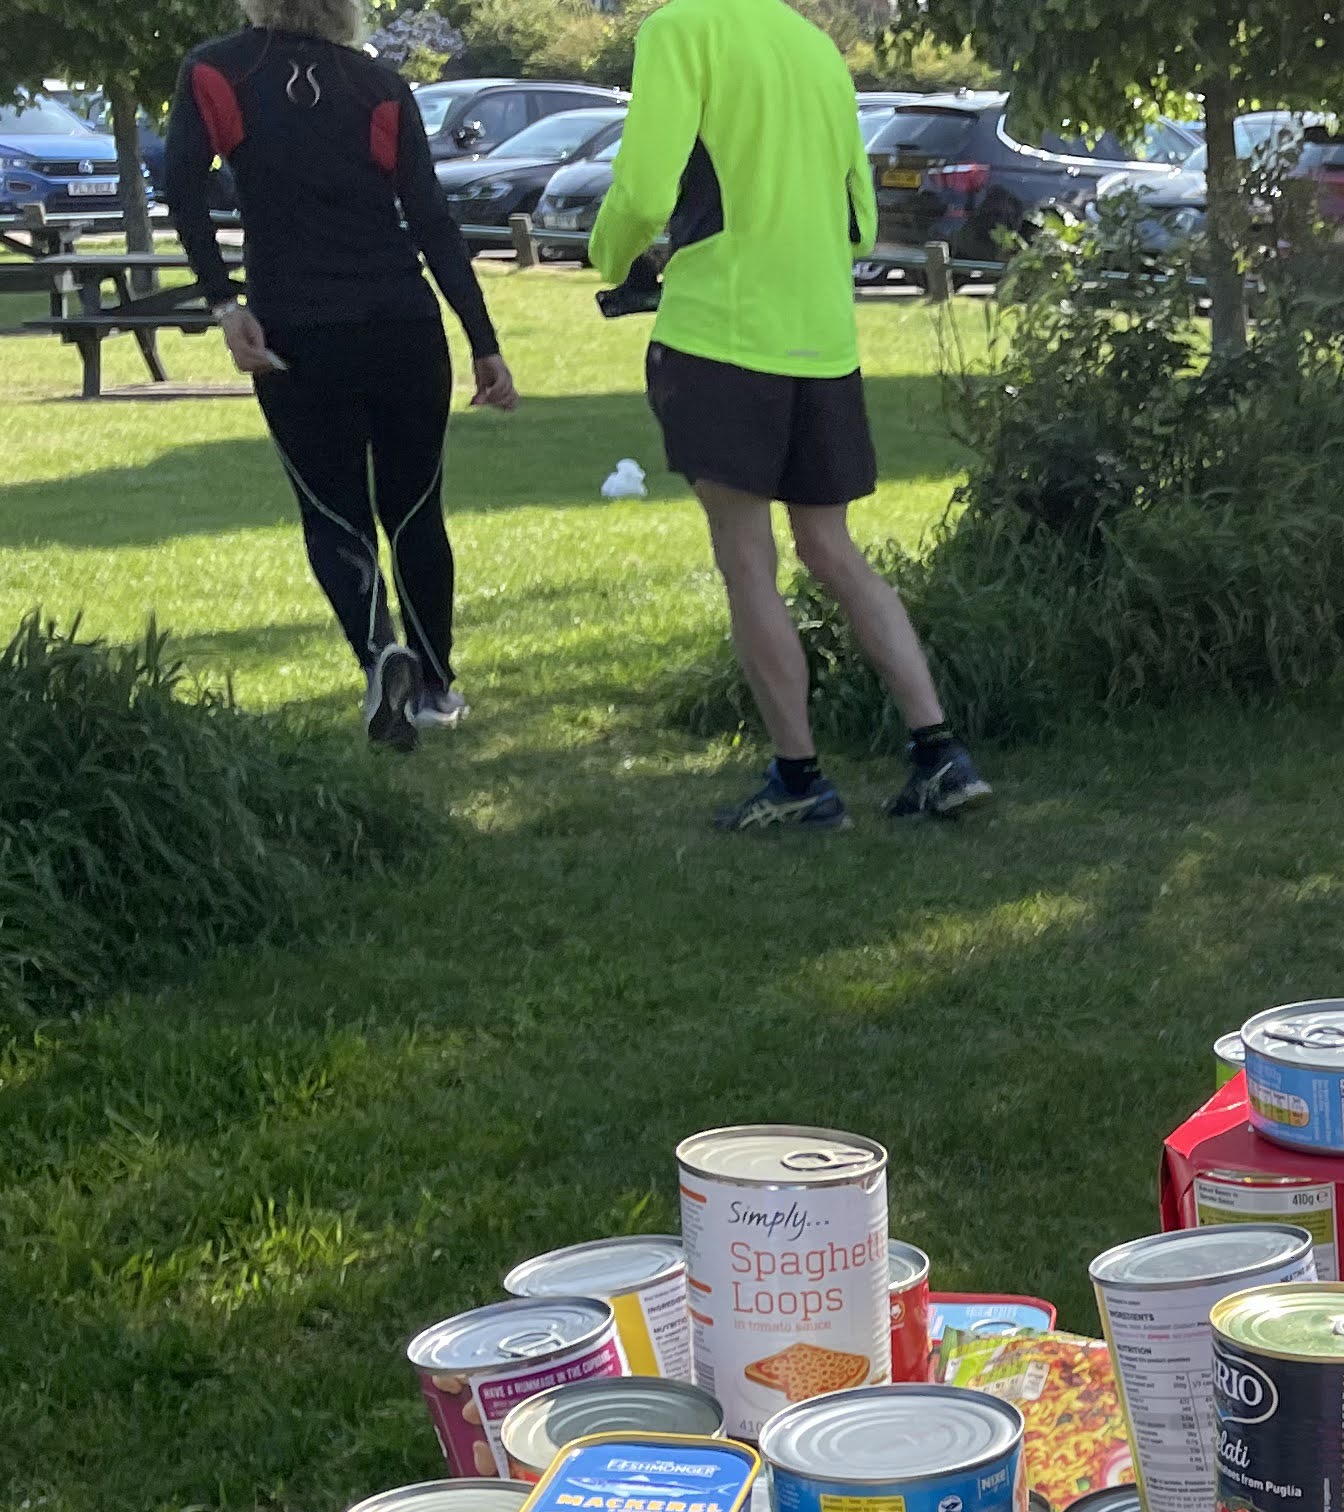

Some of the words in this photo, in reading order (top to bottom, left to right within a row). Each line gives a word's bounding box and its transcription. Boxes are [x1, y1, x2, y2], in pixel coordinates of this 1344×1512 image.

[1293, 1193, 1314, 1205] 410g
[732, 1282, 843, 1321] Loops
[749, 1321, 793, 1332] tomato
[795, 1321, 832, 1331] sauce
[1241, 1473, 1264, 1491] from
[1265, 1480, 1302, 1497] Puglia
